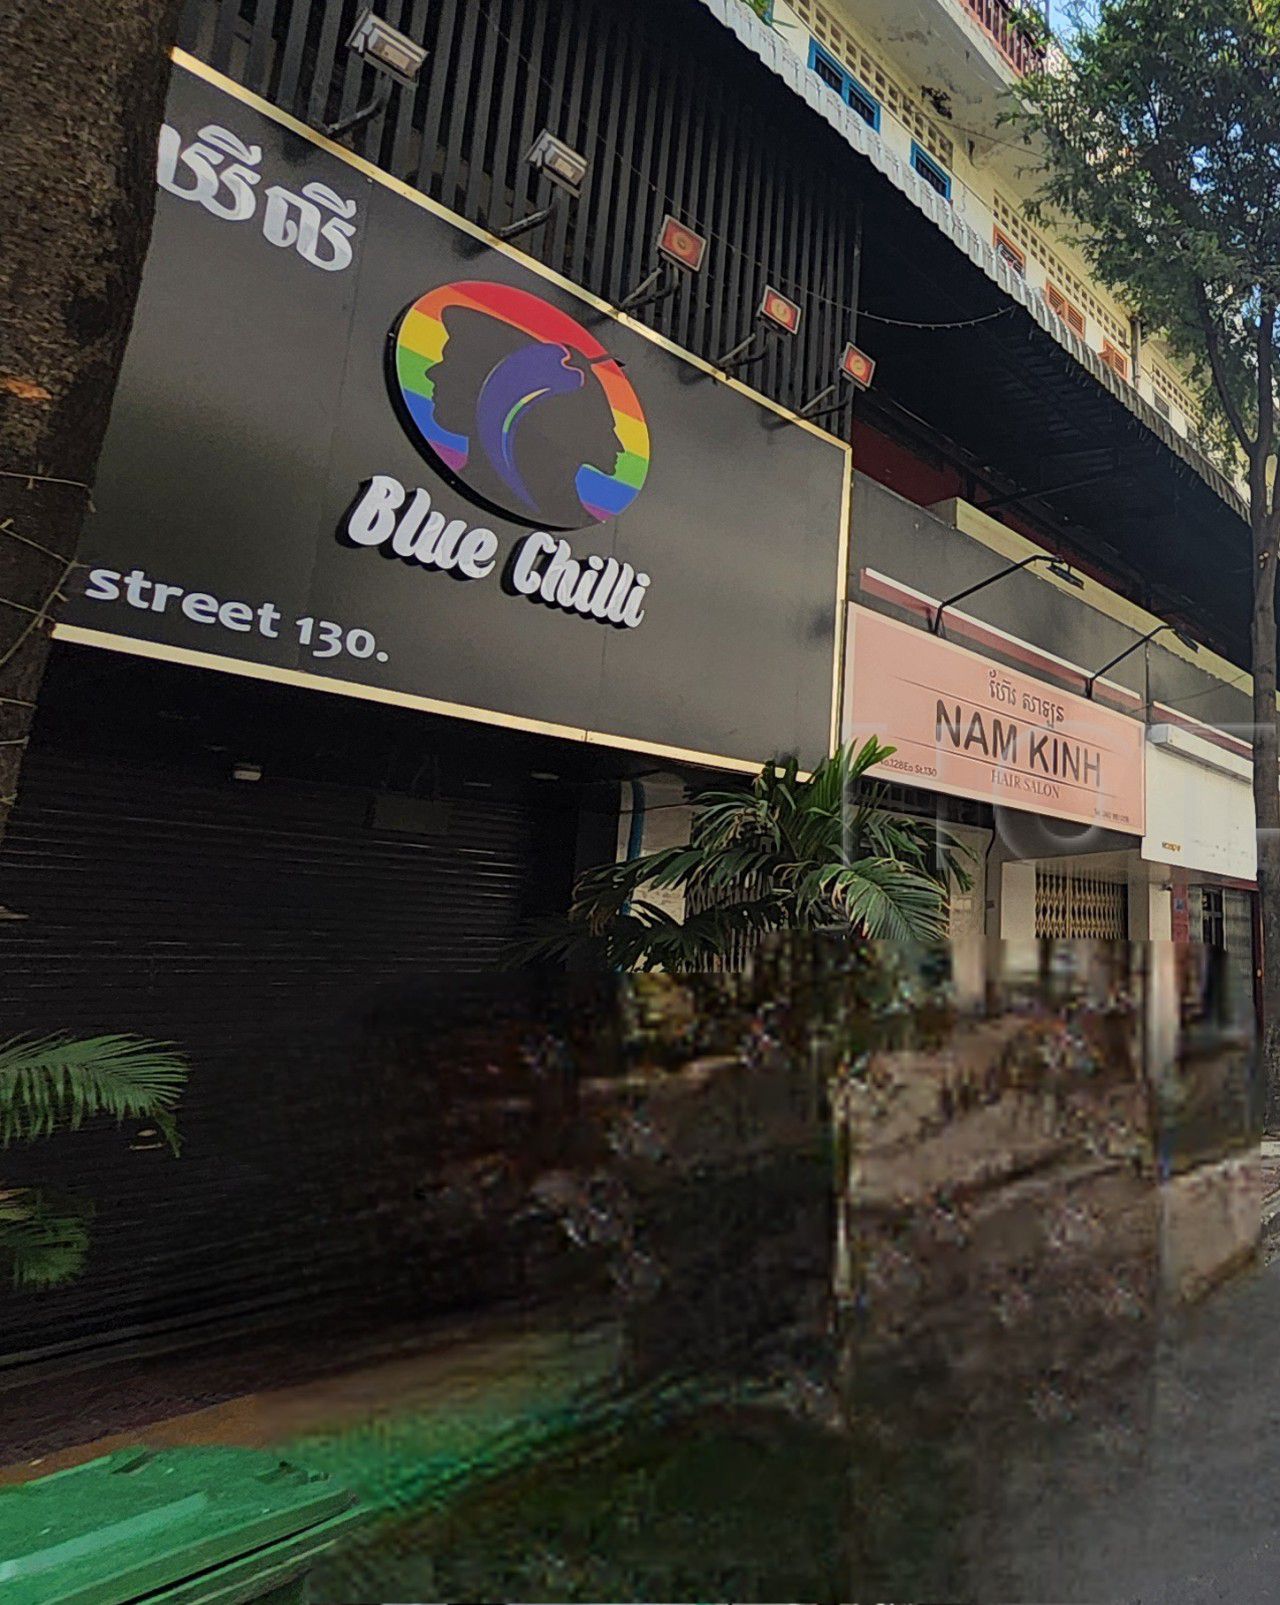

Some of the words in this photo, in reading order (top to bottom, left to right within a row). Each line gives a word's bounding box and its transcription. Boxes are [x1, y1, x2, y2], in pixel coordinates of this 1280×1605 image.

[346, 474, 499, 579] Blue
[512, 531, 652, 628] Chilli
[85, 568, 281, 638] street
[295, 616, 389, 663] 130.
[935, 699, 1017, 763] NAM
[1029, 731, 1100, 787] KINH
[991, 768, 1022, 789] HAIR
[1022, 776, 1061, 799] SALON
